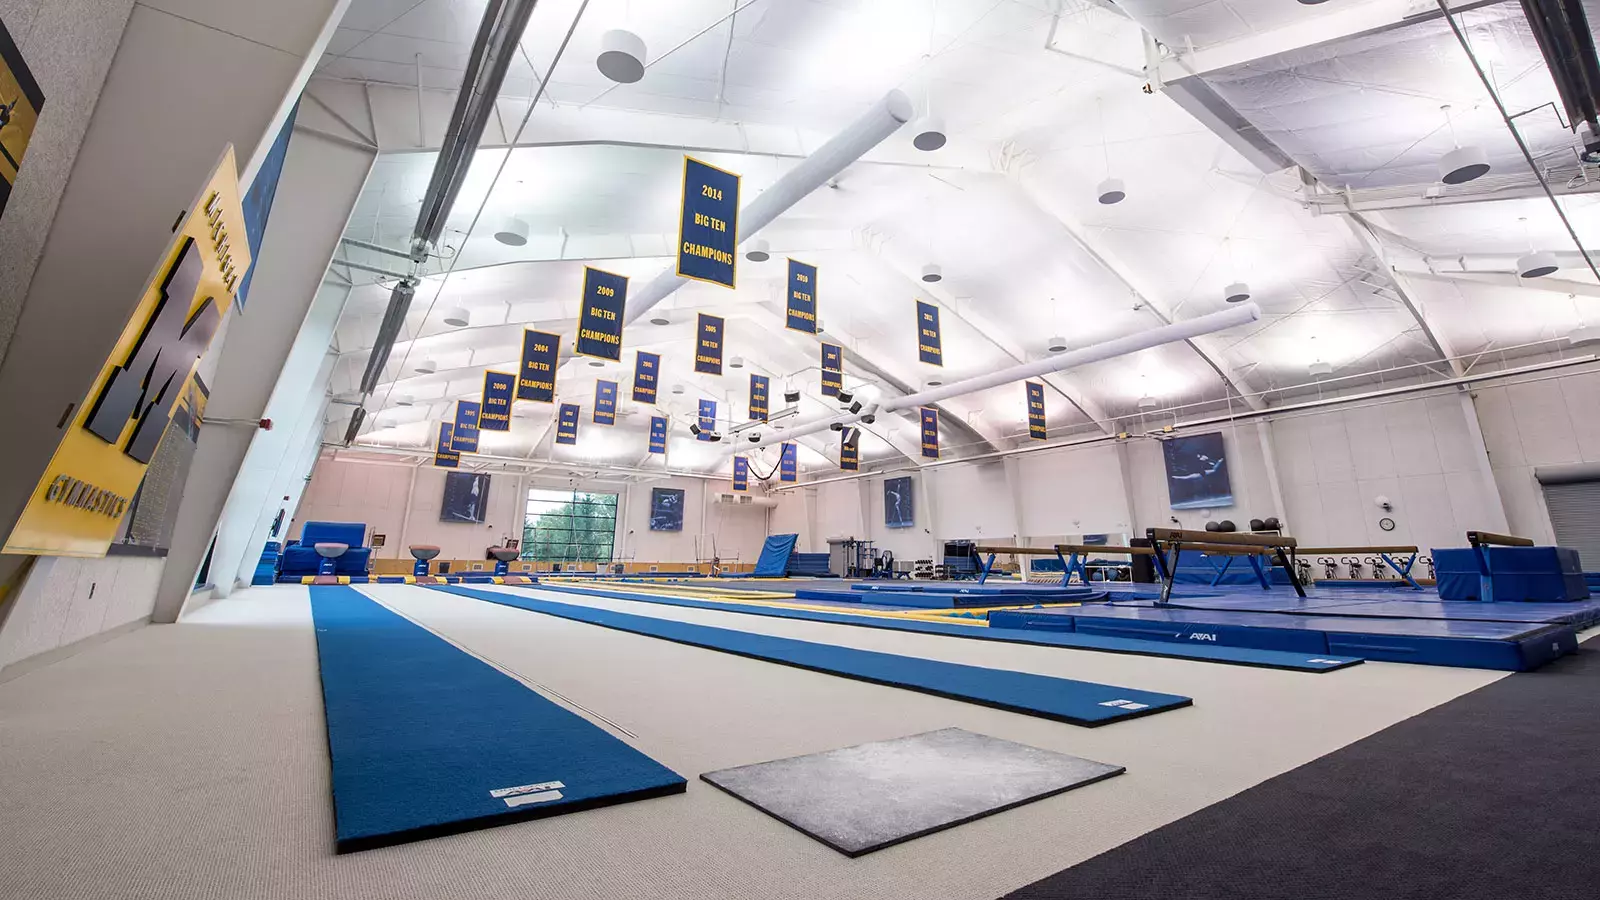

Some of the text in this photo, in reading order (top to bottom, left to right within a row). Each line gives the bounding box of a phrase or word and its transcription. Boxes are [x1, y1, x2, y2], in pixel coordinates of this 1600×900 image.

[702, 184, 722, 201] 2014
[695, 212, 726, 232] BIG TEN
[205, 190, 239, 294] MICHIGAN
[683, 241, 733, 265] CHAMPIONS
[597, 285, 614, 297] 2009
[793, 290, 811, 302] BIG TEN
[590, 306, 616, 321] BIG TEN
[788, 308, 815, 322] CHAMPIONS
[581, 328, 620, 345] CHAMPIONS
[533, 343, 549, 353] 2004
[528, 360, 550, 371] BIG TEN
[697, 354, 721, 365] CHAMPIONS
[520, 379, 553, 391] CHAMPIONS
[481, 412, 509, 421] CHAMPIONS
[46, 474, 127, 518] GYMNASTICS
